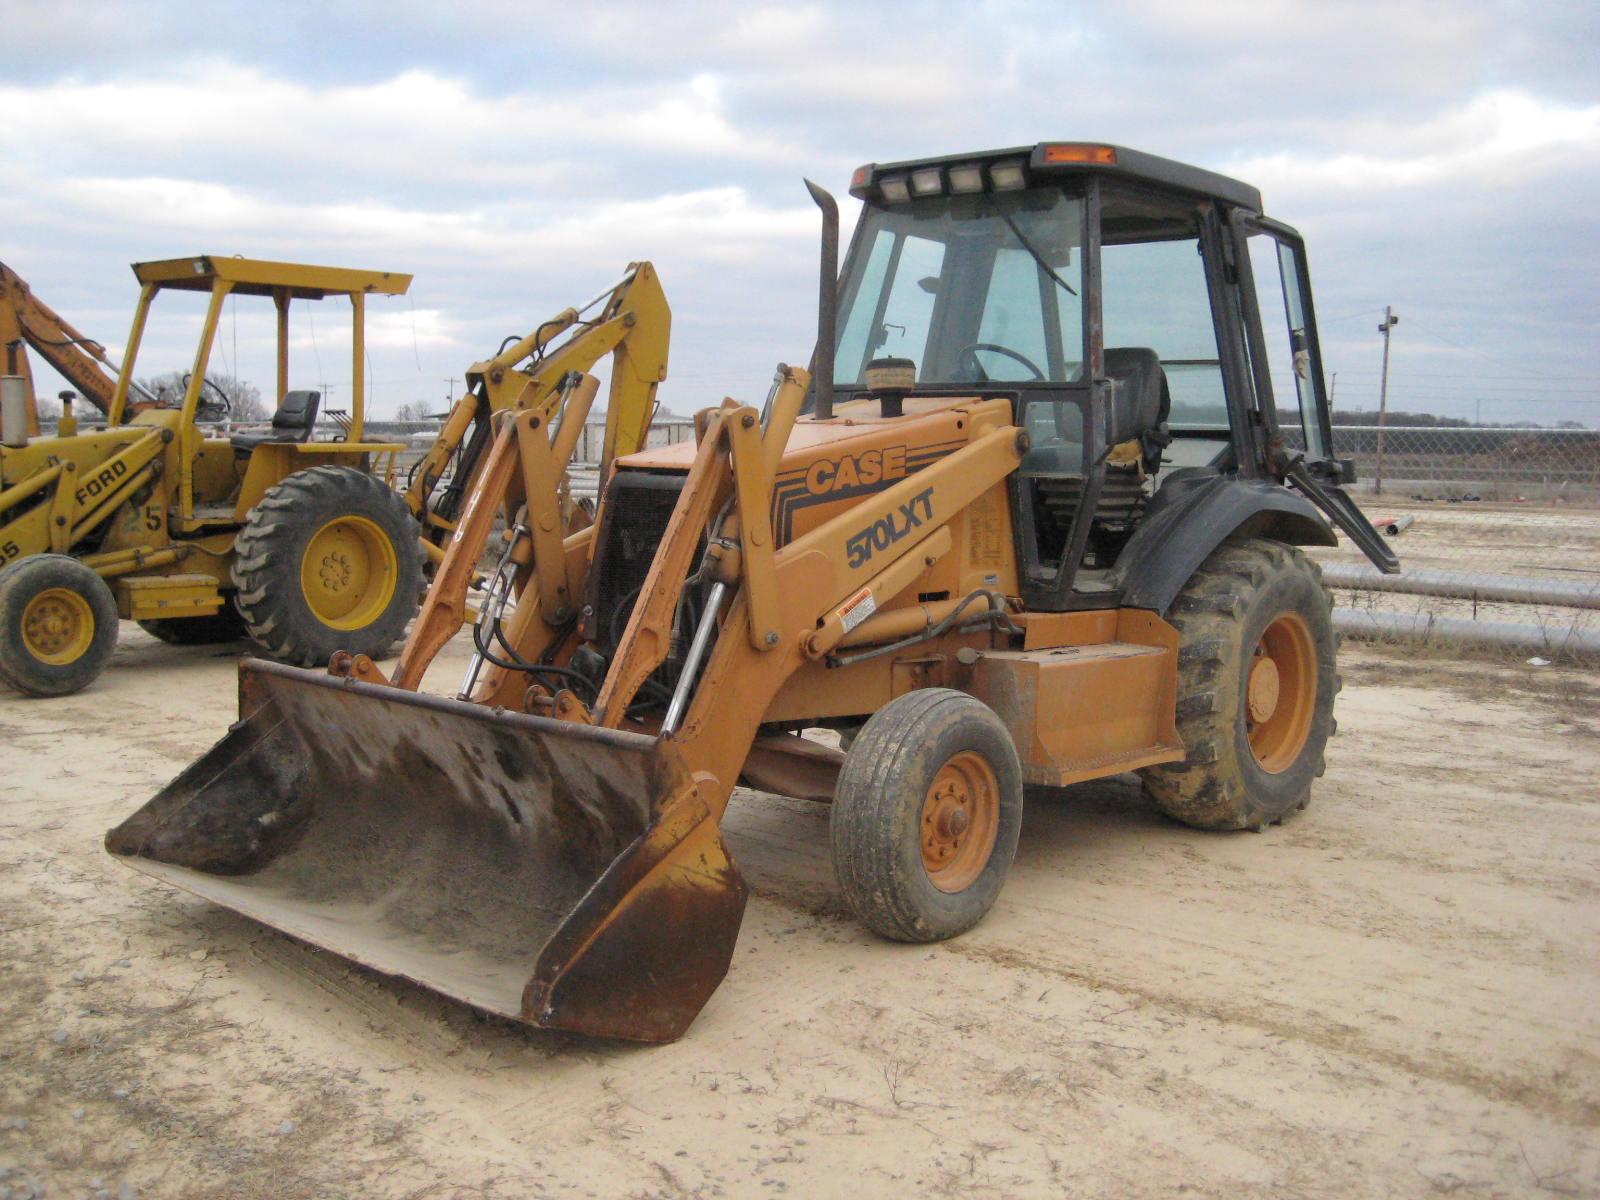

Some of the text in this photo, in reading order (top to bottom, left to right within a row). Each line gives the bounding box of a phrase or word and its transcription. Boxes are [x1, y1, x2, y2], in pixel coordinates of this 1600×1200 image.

[75, 459, 127, 506] FORD
[806, 445, 906, 494] CASE
[846, 487, 934, 569] 570LXT
